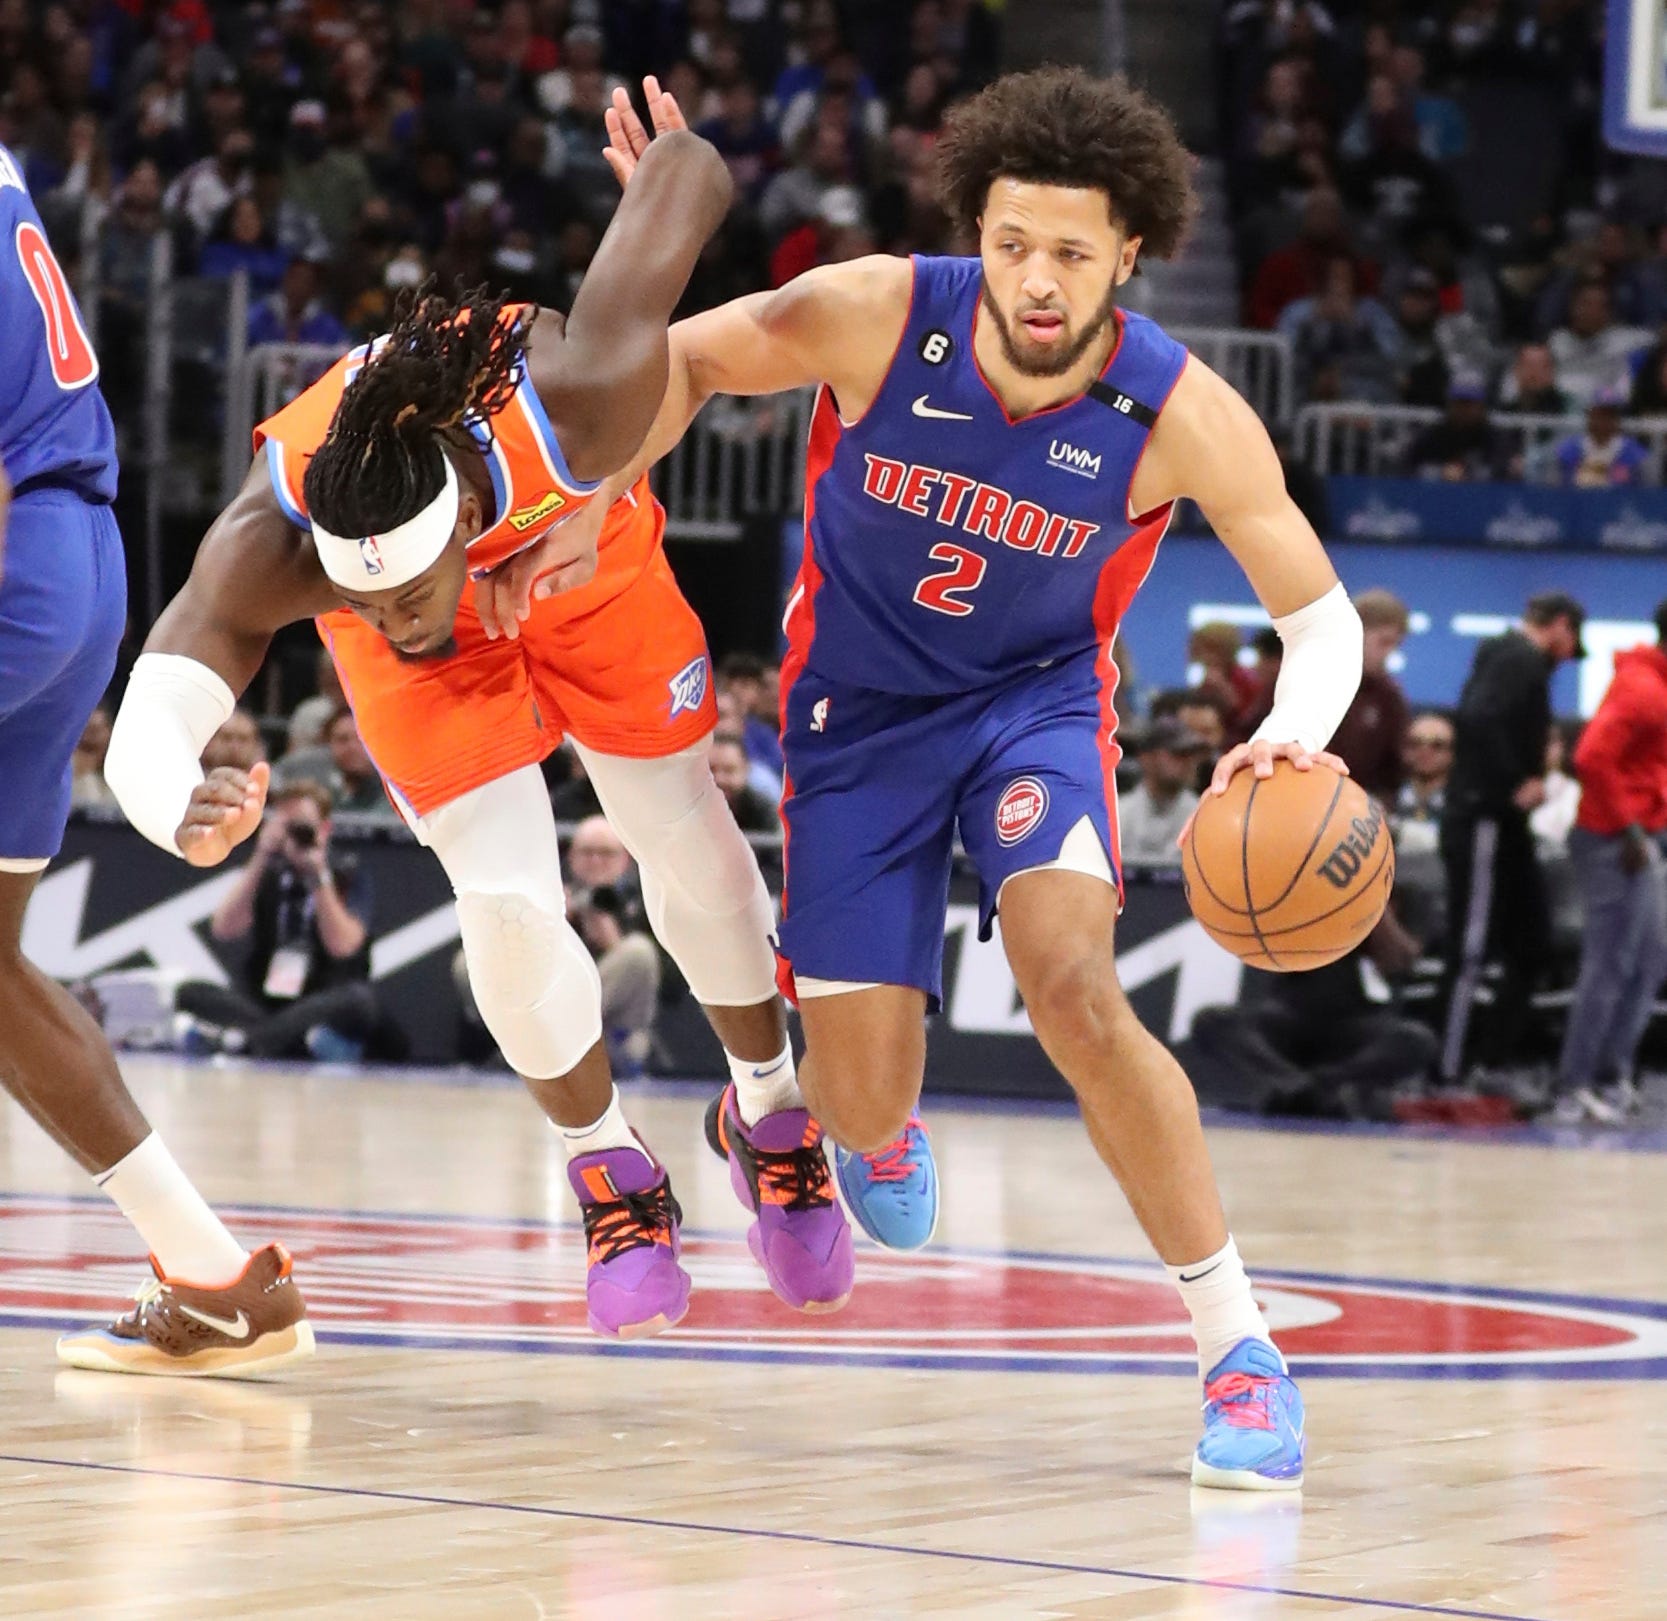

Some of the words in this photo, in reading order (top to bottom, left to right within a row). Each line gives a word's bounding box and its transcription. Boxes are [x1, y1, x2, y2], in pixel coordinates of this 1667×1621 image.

[16, 221, 99, 390] 0
[922, 333, 949, 363] 6
[1113, 394, 1133, 414] 16
[1049, 439, 1102, 473] UWM
[864, 453, 1100, 558] DETROIT
[913, 542, 987, 616] 2
[1001, 806, 1035, 827] PISTONS
[1002, 795, 1036, 815] DETROIT
[1317, 797, 1385, 888] Wilso
